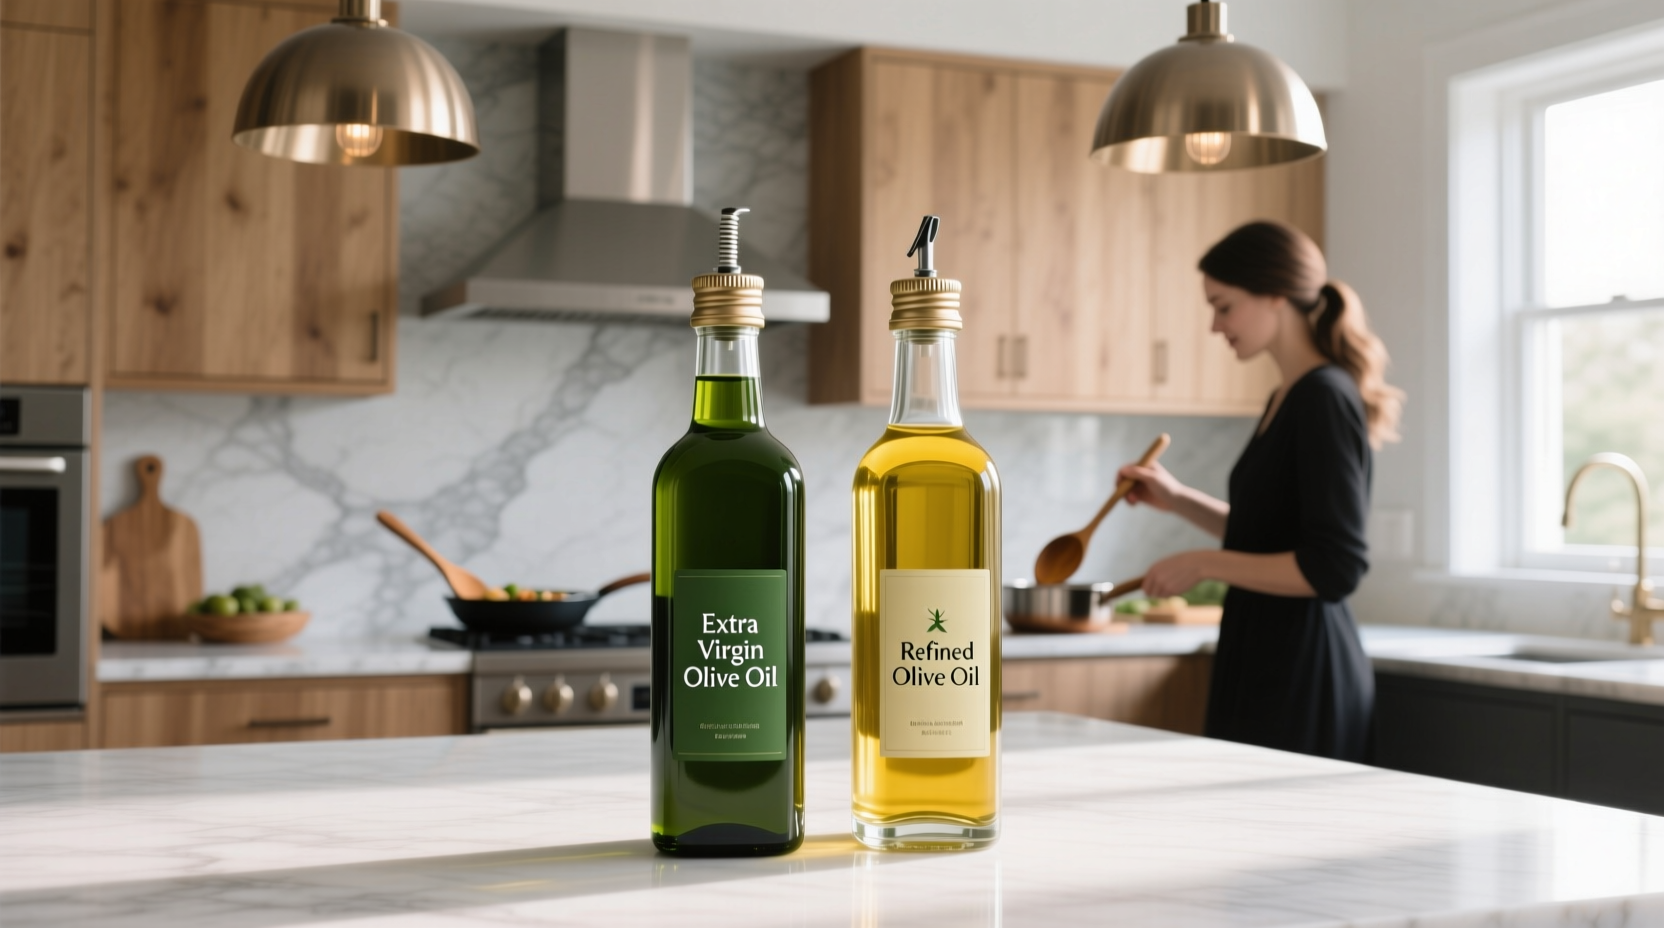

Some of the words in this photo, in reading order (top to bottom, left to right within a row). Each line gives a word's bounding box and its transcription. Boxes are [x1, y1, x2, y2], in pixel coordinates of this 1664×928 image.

[702, 612, 758, 634] Extra
[697, 639, 764, 666] Virgin
[900, 640, 974, 661] Refined
[683, 665, 740, 688] Olive
[745, 665, 778, 688] Oil
[892, 665, 946, 686] Olive
[950, 665, 979, 686] Oil
